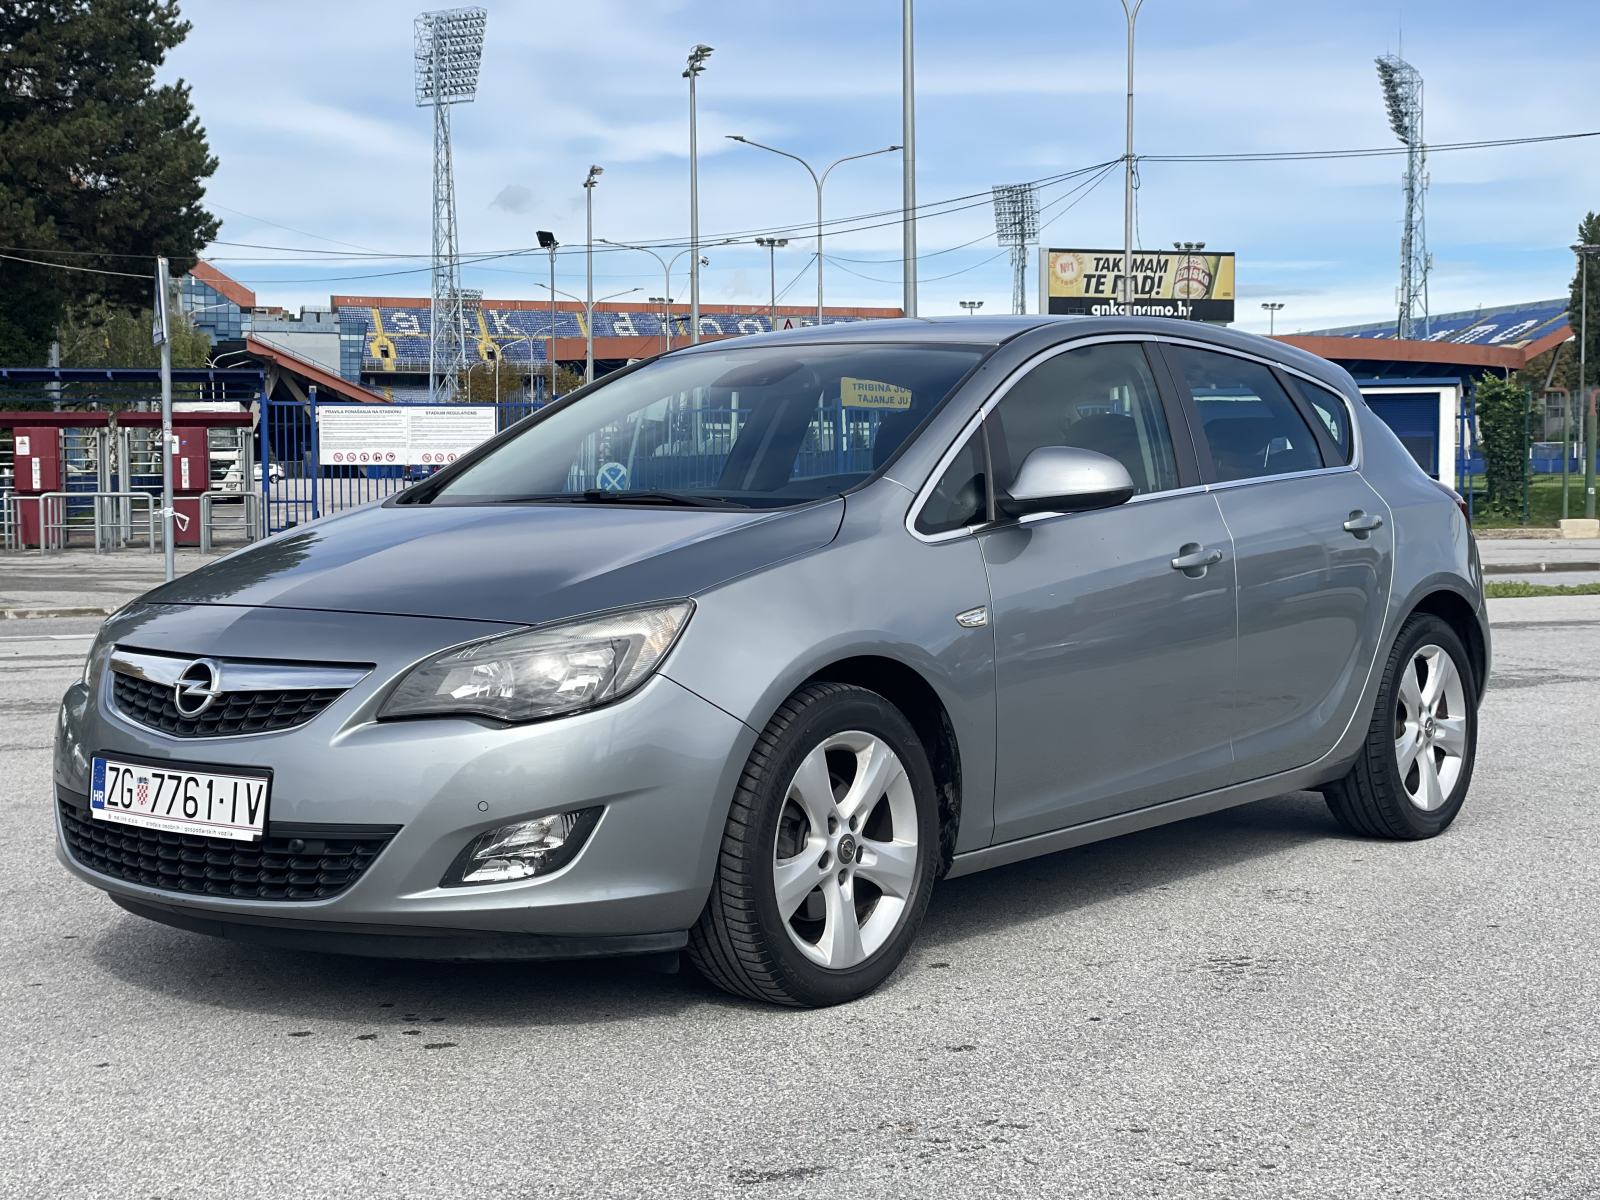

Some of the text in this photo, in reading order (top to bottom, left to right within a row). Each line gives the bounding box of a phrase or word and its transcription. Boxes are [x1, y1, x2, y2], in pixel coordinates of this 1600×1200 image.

[1094, 257, 1123, 272] TAK
[1131, 257, 1169, 273] MAM
[1083, 274, 1107, 294] TE
[1091, 300, 1192, 316] gnknamo.hr
[852, 383, 891, 392] TRIBINA
[106, 766, 134, 809] ZG
[93, 790, 104, 802] HR
